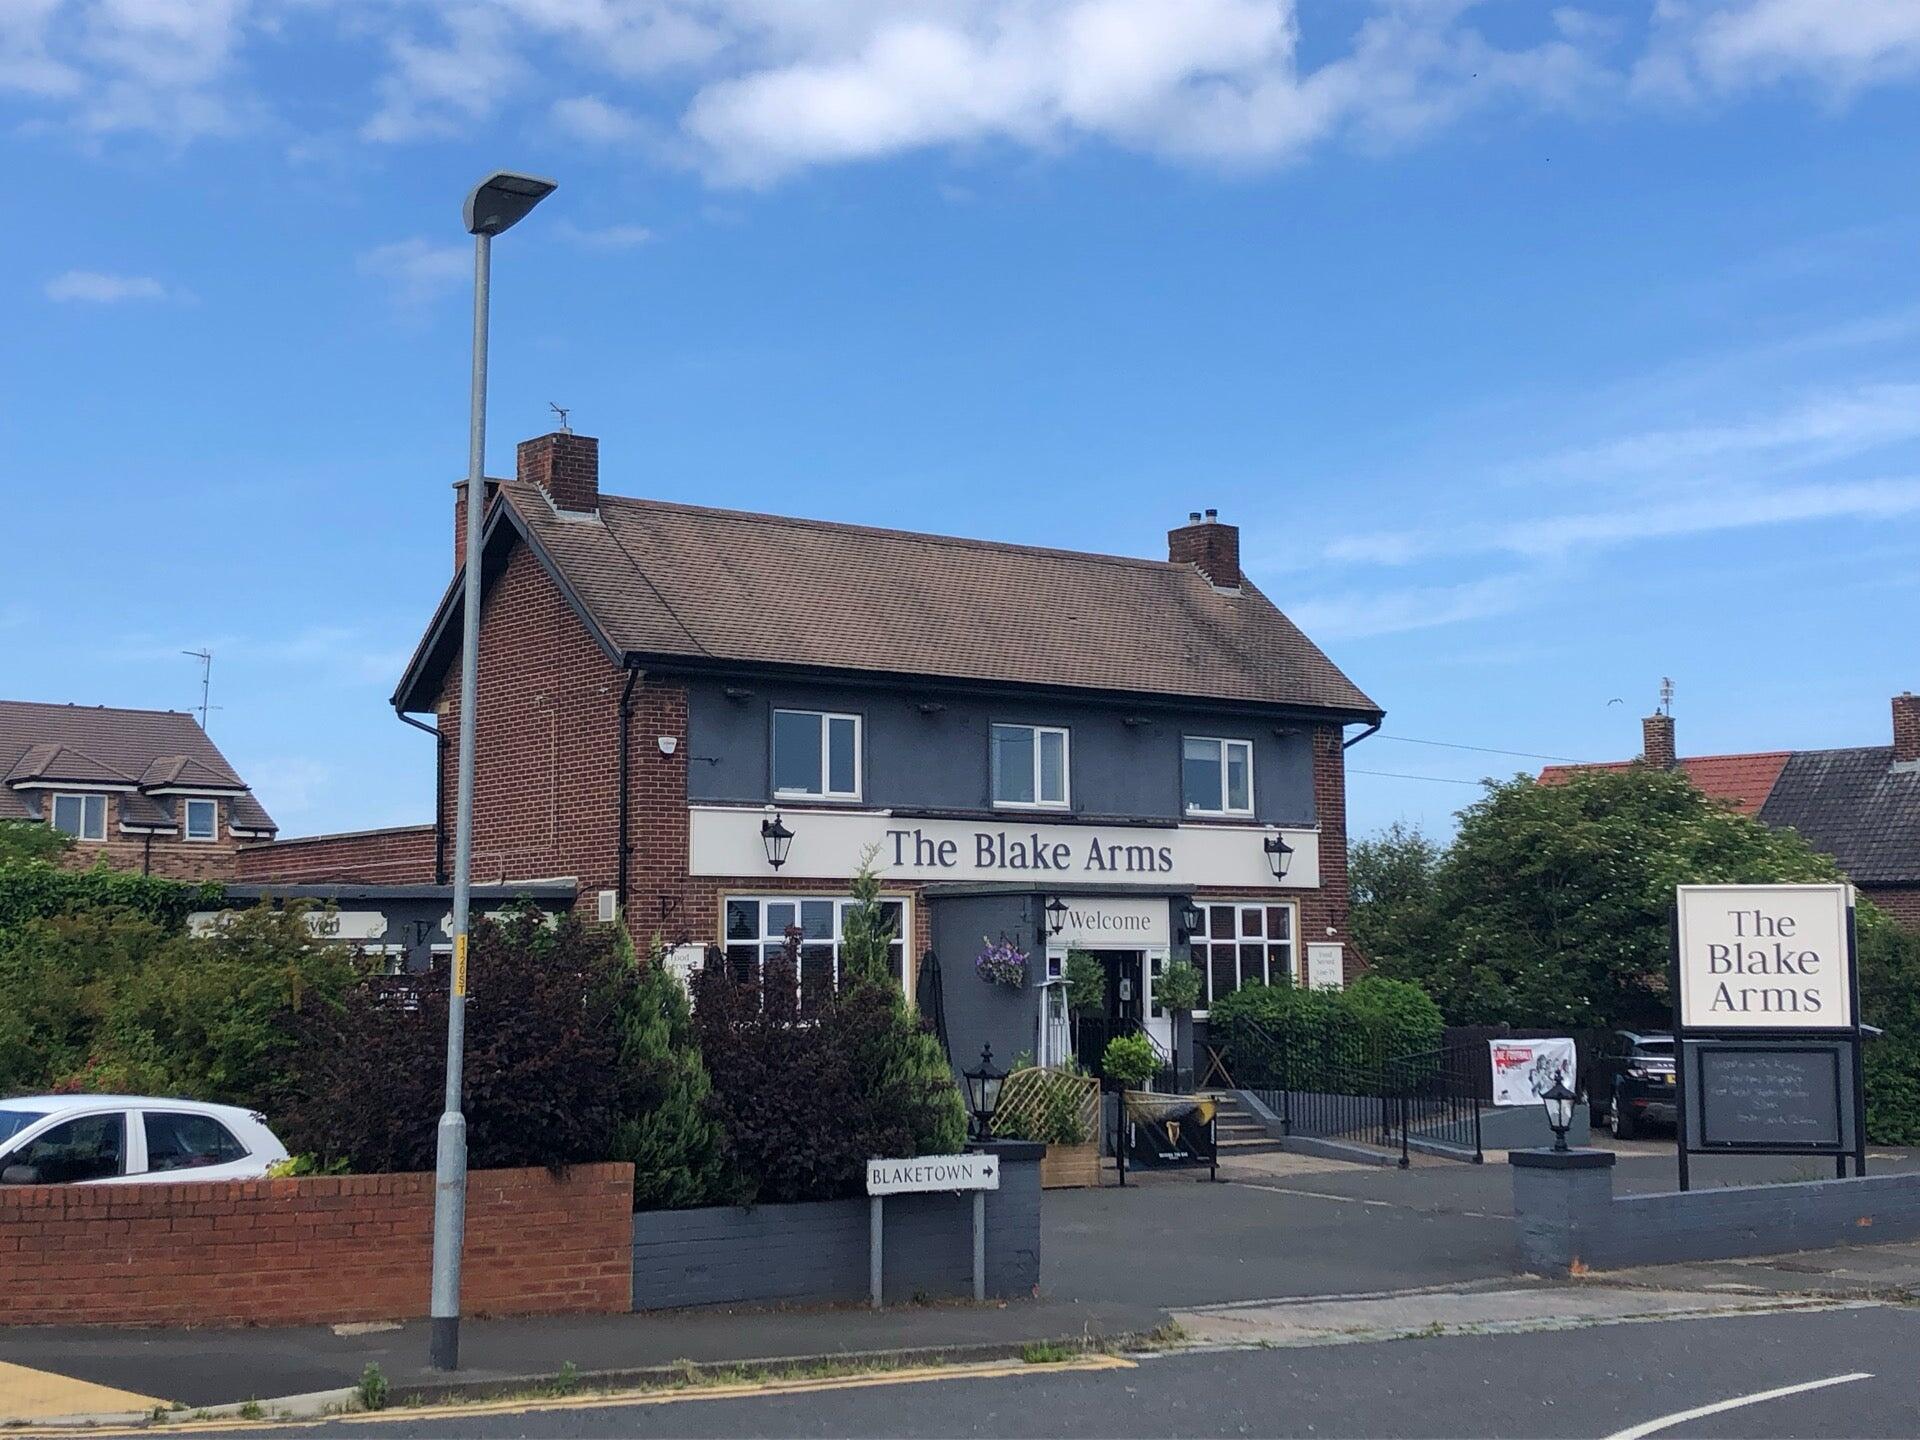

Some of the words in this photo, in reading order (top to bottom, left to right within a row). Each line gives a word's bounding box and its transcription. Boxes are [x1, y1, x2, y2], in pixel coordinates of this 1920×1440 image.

[886, 829, 957, 867] The
[974, 832, 1071, 871] Blake
[1084, 837, 1173, 872] Arms
[1068, 910, 1151, 931] Welcome
[1727, 909, 1796, 937] The
[1707, 942, 1820, 975] Blake
[1709, 981, 1822, 1013] Arms
[873, 1164, 973, 1185] BLAKETOWN
